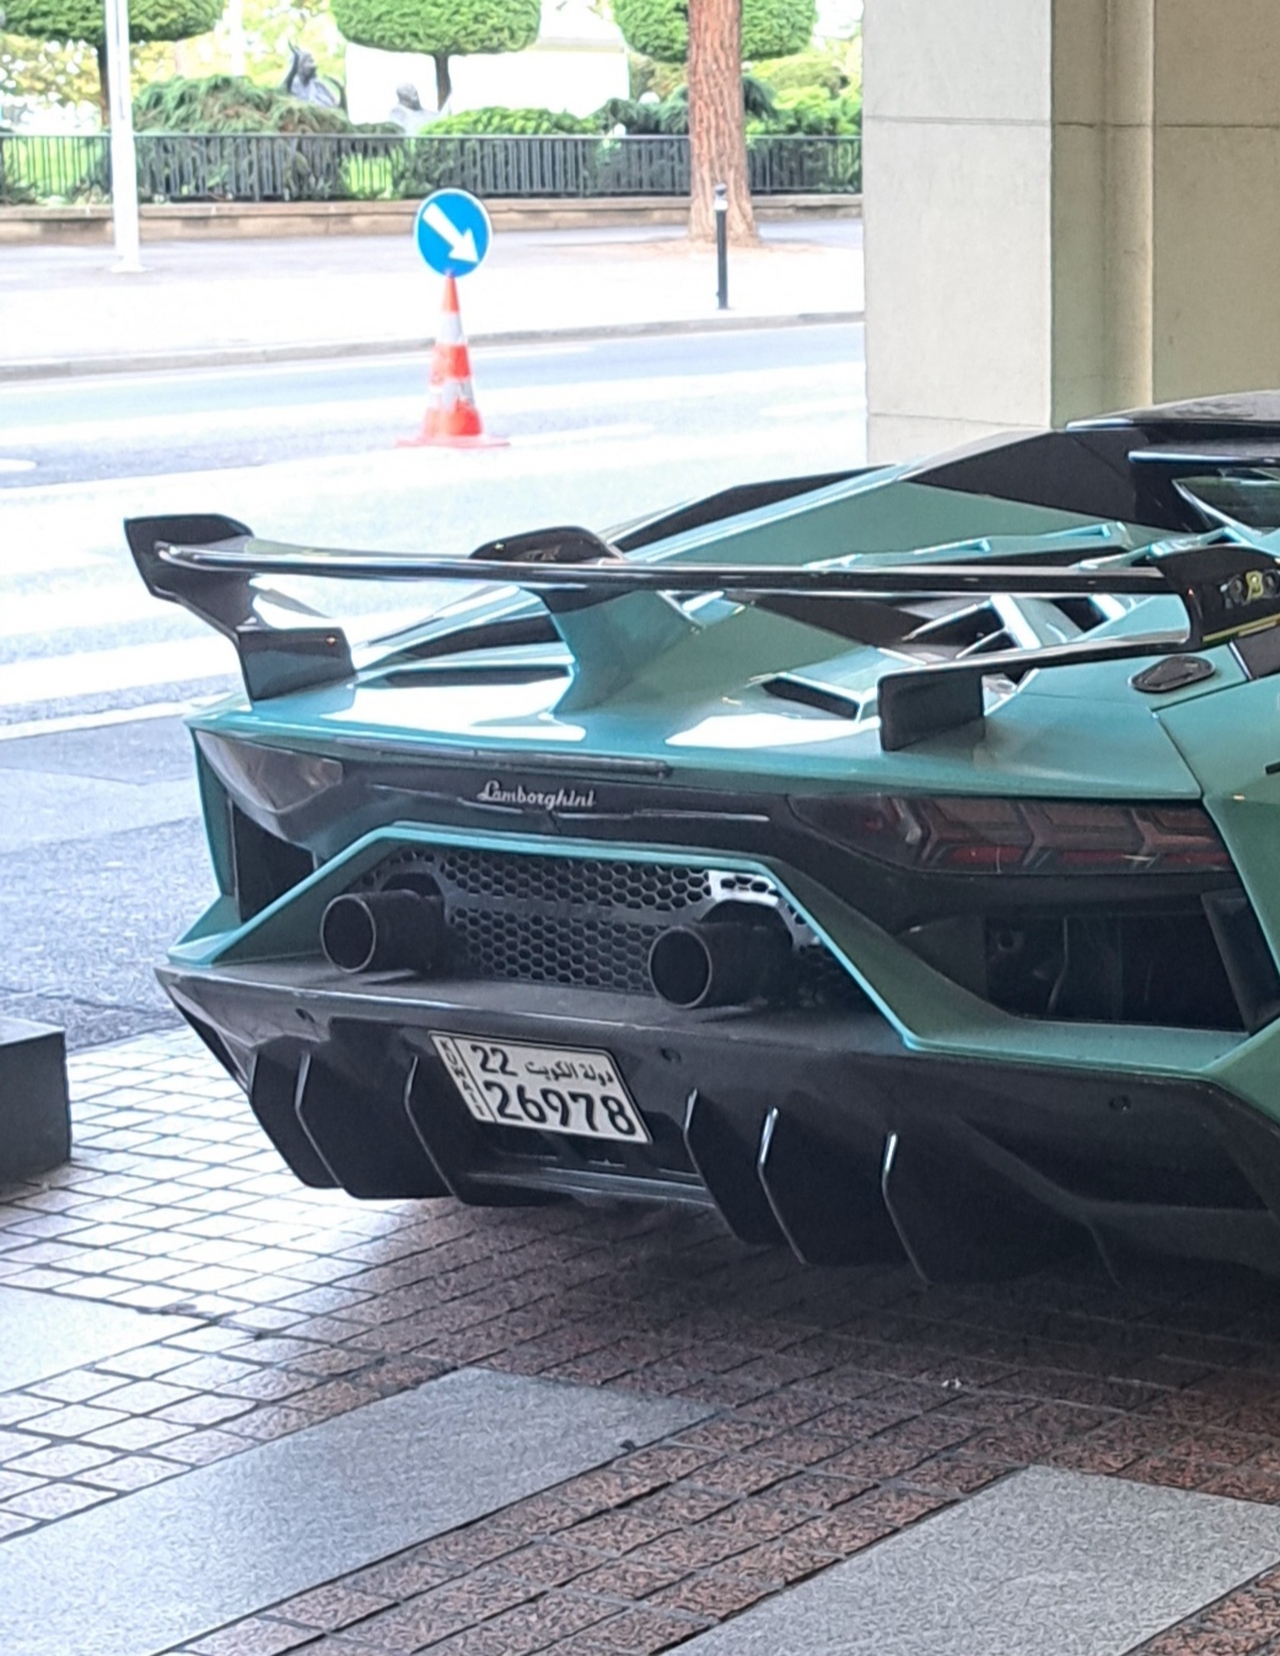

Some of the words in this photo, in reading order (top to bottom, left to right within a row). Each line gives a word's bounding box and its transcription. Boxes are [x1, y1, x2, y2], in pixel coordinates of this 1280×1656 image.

[476, 780, 596, 810] Lamborghini
[470, 1044, 518, 1077] 22
[524, 1060, 578, 1081] الكويت
[579, 1063, 614, 1086] دولة
[439, 1039, 486, 1117] KUWAIT
[483, 1081, 636, 1135] 26978
